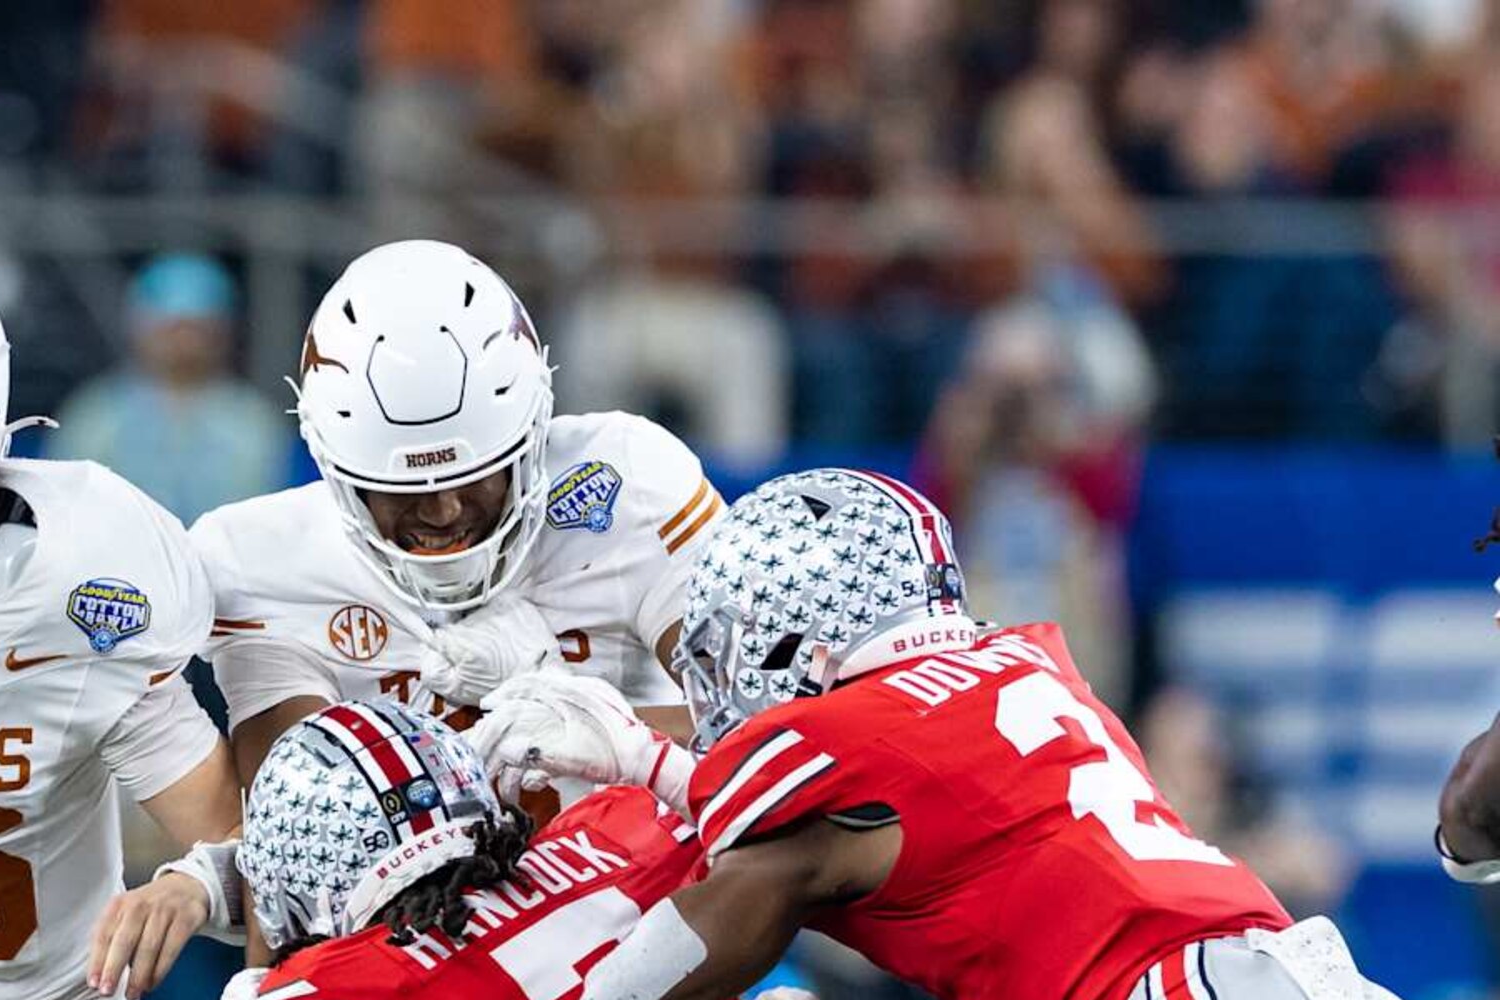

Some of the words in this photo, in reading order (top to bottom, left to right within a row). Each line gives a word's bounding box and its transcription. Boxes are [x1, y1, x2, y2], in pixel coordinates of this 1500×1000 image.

[406, 447, 456, 467] HORNS
[548, 468, 616, 523] COTTON
[566, 486, 609, 520] BOWL
[73, 596, 145, 627] COTTON
[86, 610, 138, 630] BOWL
[331, 607, 386, 659] SEC
[881, 634, 1061, 706] DOWN
[995, 670, 1236, 867] 2
